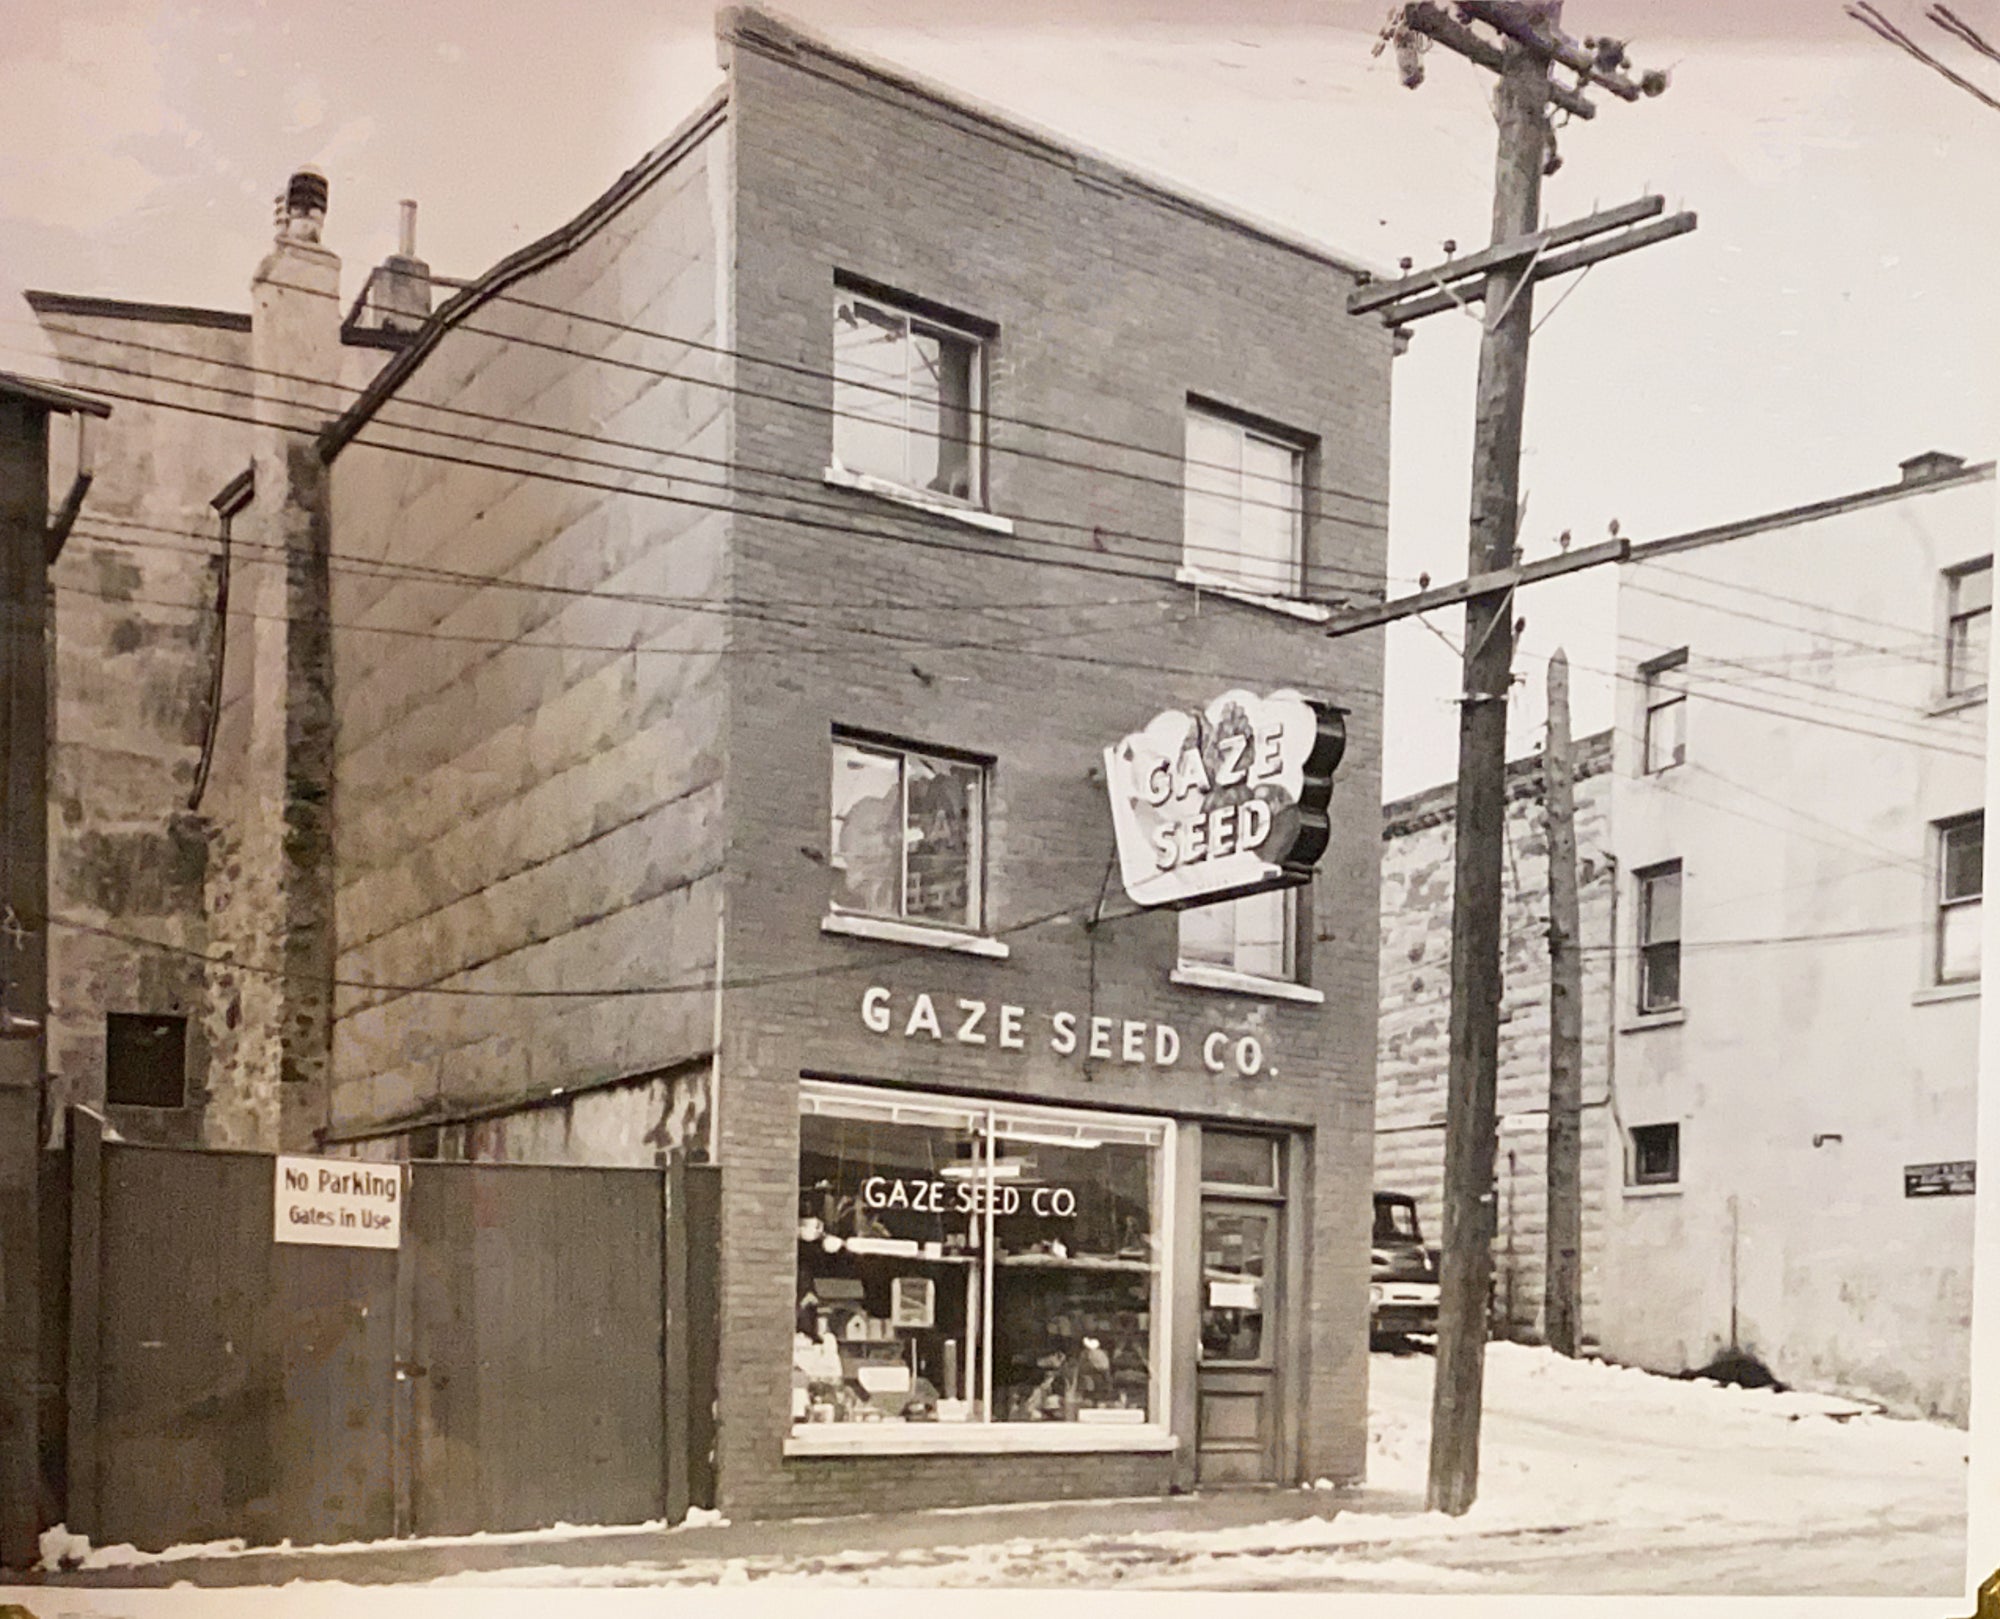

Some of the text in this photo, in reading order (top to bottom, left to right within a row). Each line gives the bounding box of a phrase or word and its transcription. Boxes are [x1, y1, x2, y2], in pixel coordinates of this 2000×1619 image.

[1148, 722, 1284, 808] GAZE
[1152, 798, 1272, 872] SEED
[861, 986, 1280, 1077] GAZE SEED CO.
[285, 1167, 397, 1203] No Parking
[864, 1176, 1078, 1218] GAZE SEED CO.
[289, 1204, 392, 1230] Gates in Use
